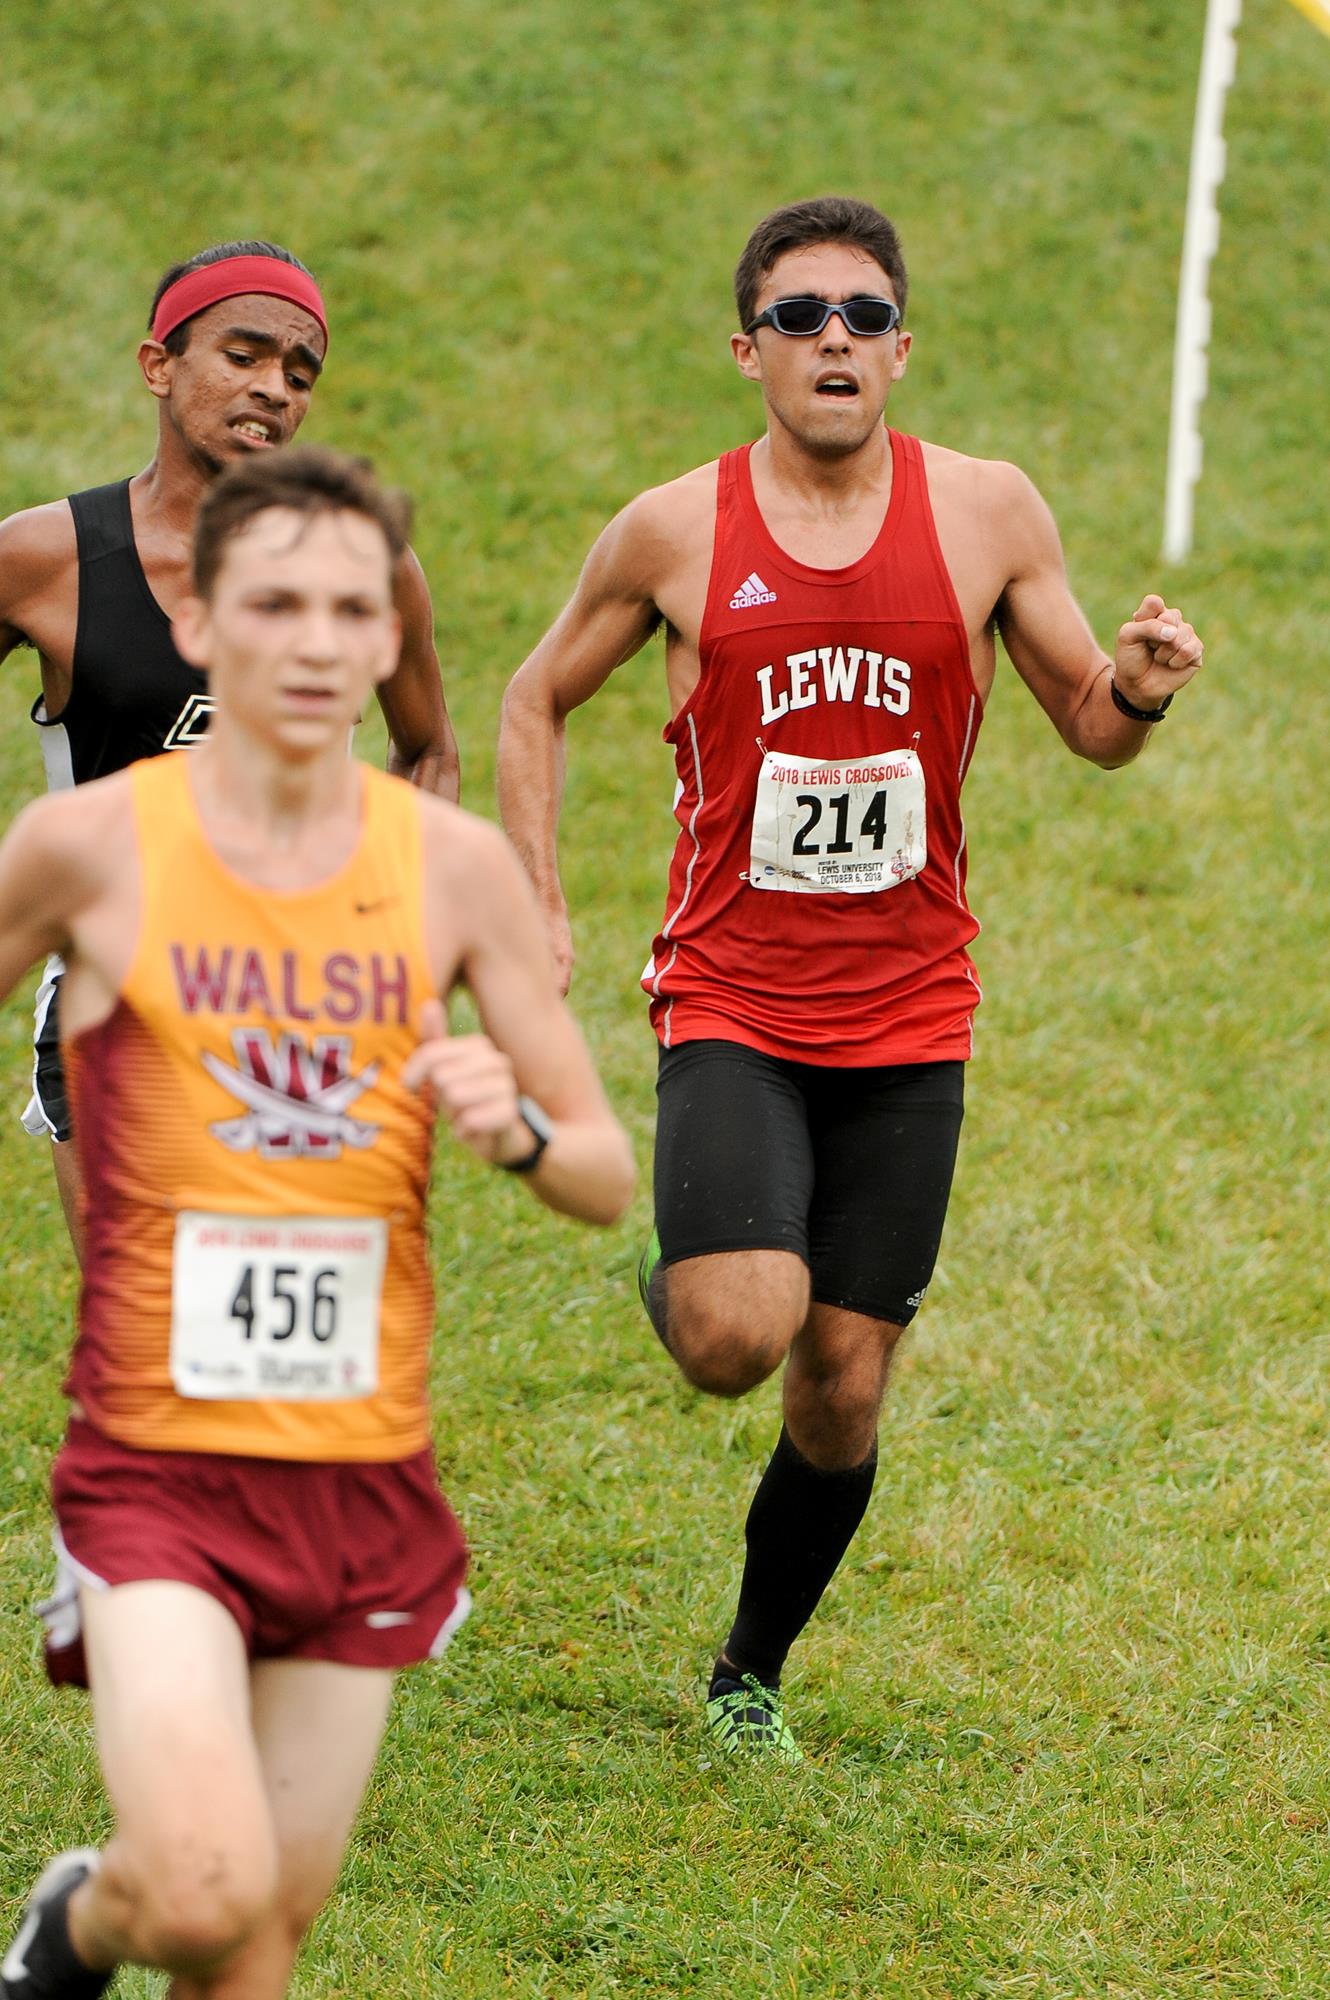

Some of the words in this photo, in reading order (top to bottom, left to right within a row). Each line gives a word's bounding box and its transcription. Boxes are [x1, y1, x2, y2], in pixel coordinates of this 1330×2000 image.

[729, 590, 777, 609] adidas
[756, 646, 911, 726] LEWIS
[771, 765, 799, 784] 2018
[803, 768, 841, 785] LEWIS
[793, 790, 887, 856] 214
[817, 865, 840, 875] LEWIS
[841, 862, 884, 873] UNIVERSITY
[820, 874, 854, 885] OCTOBER
[864, 872, 882, 882] 2018
[170, 942, 409, 1024] WALSH
[230, 1265, 338, 1342] 456
